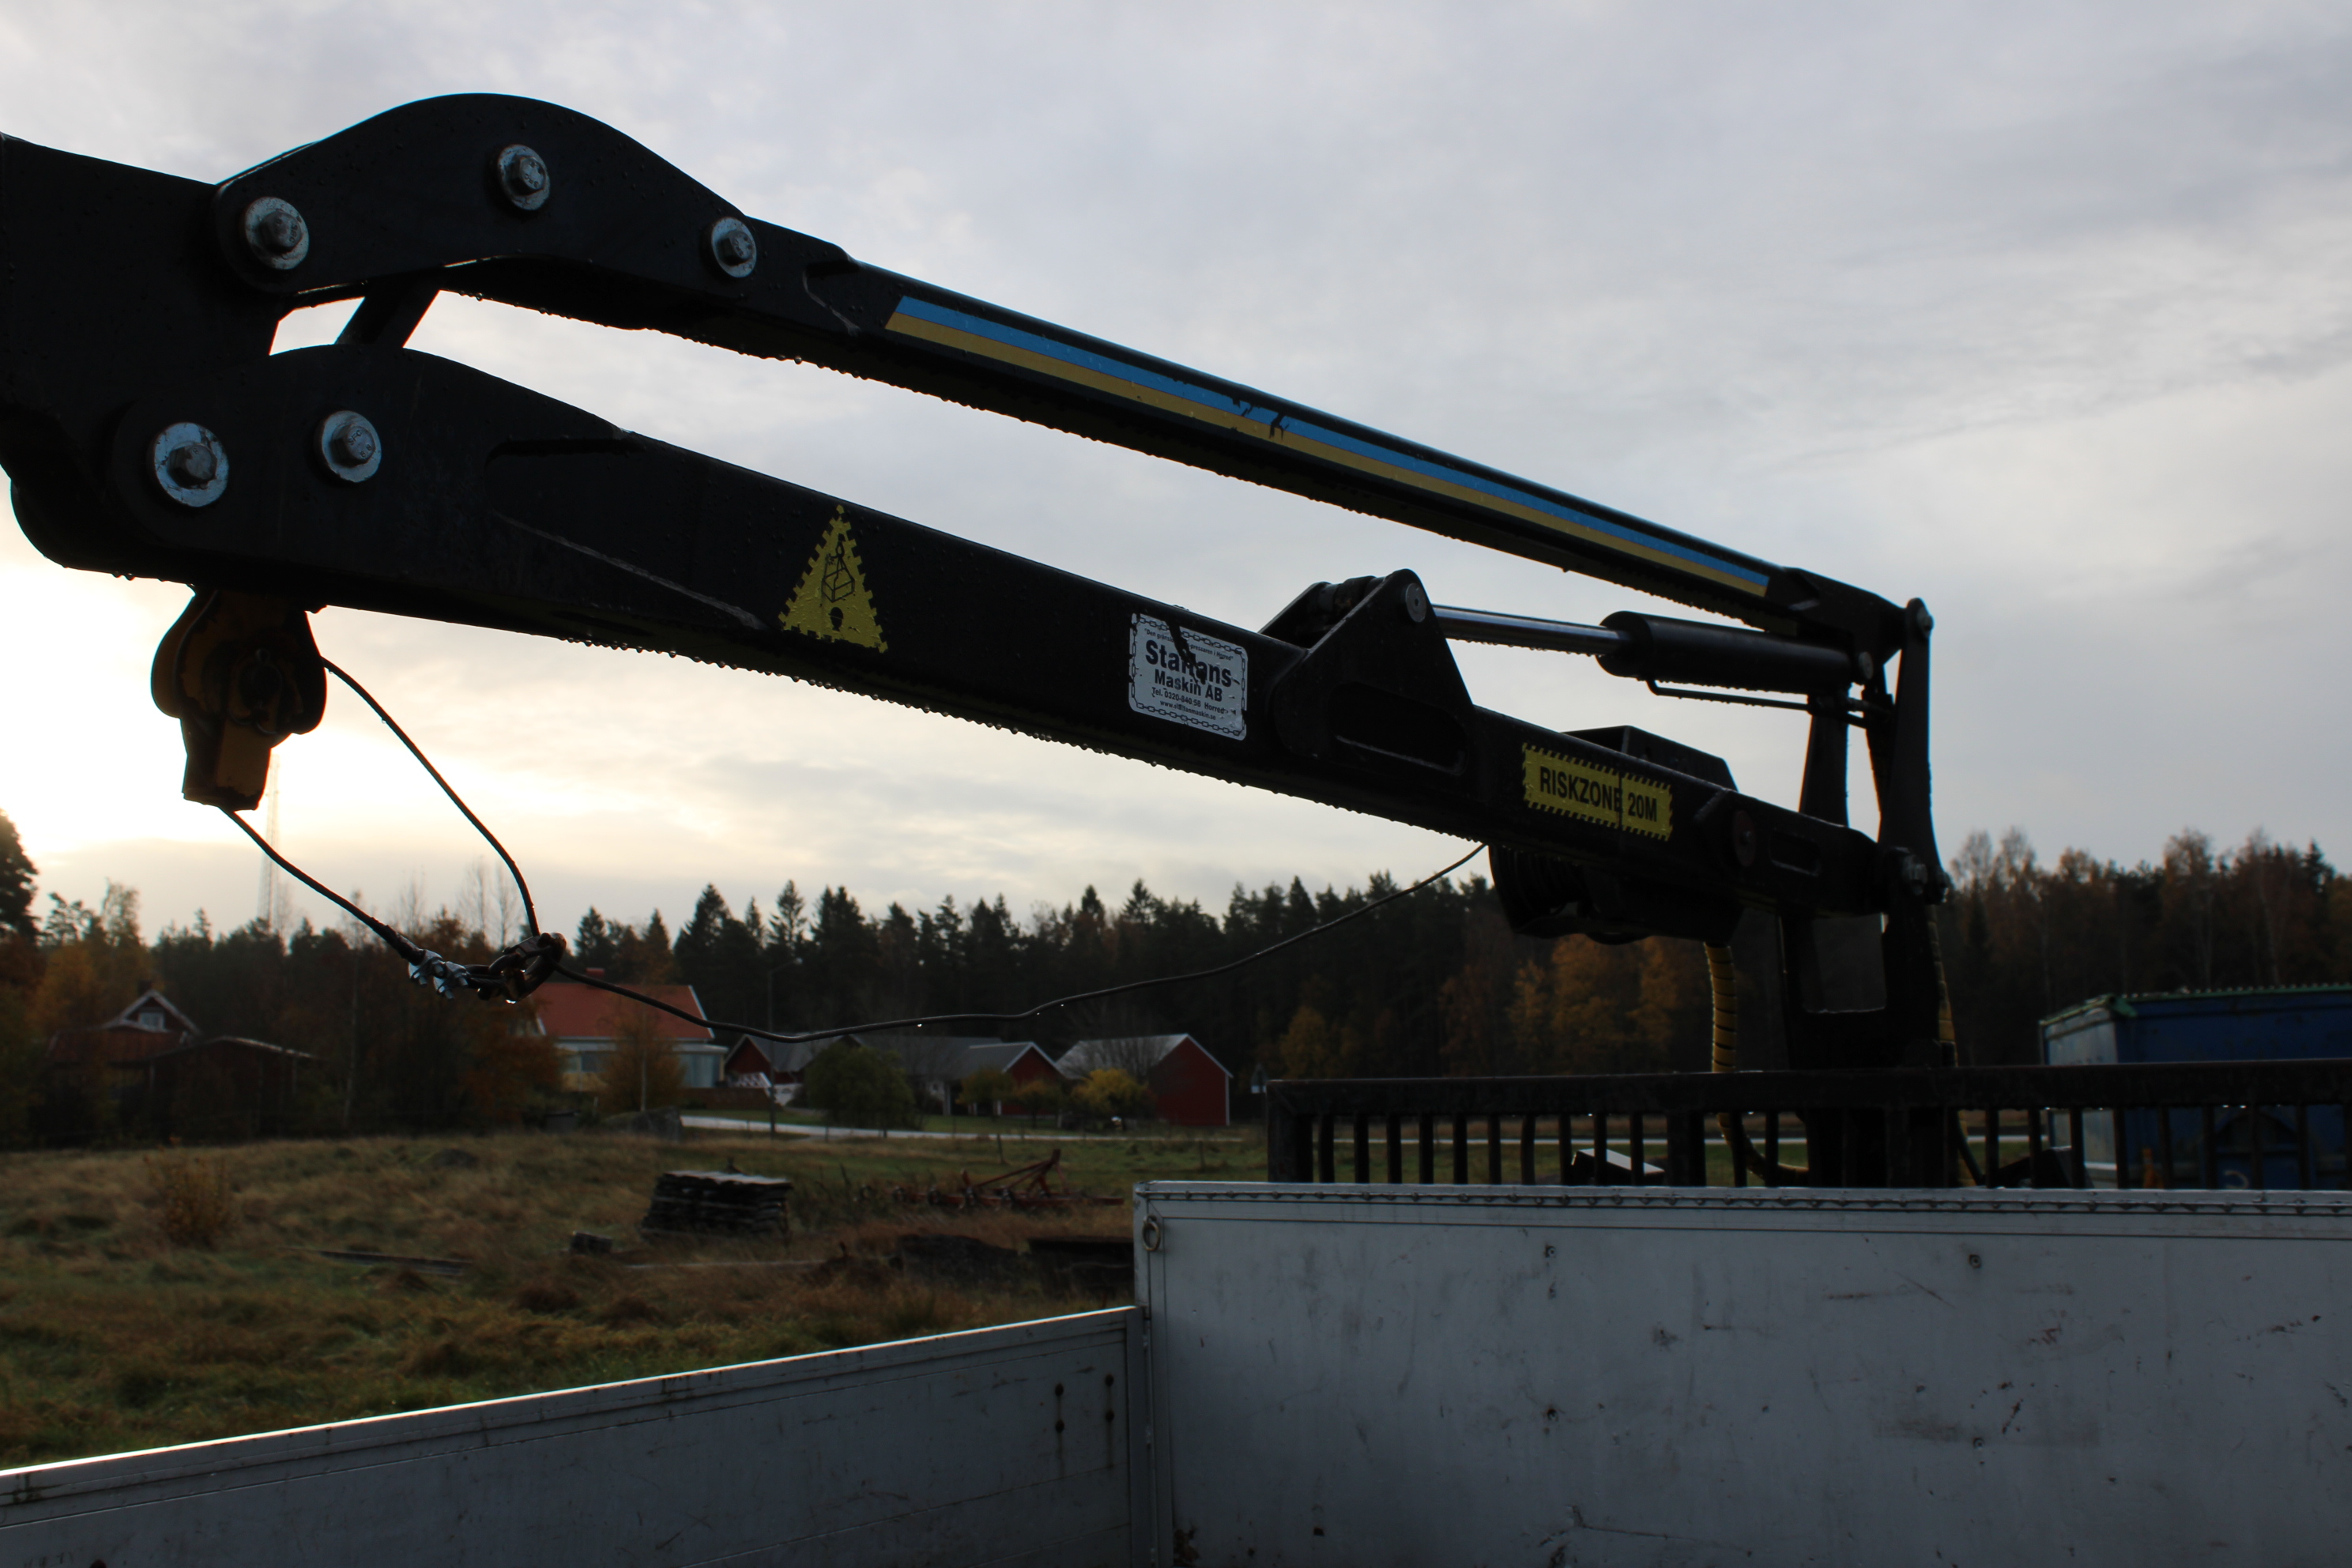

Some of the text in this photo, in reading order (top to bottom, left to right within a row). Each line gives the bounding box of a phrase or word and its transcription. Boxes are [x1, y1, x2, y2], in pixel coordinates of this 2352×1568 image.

[1152, 687, 1163, 696] Tel.
[1204, 702, 1225, 714] Horred
[1154, 669, 1223, 702] Maskin AB
[1540, 766, 1657, 823] RISKZONE 20M
